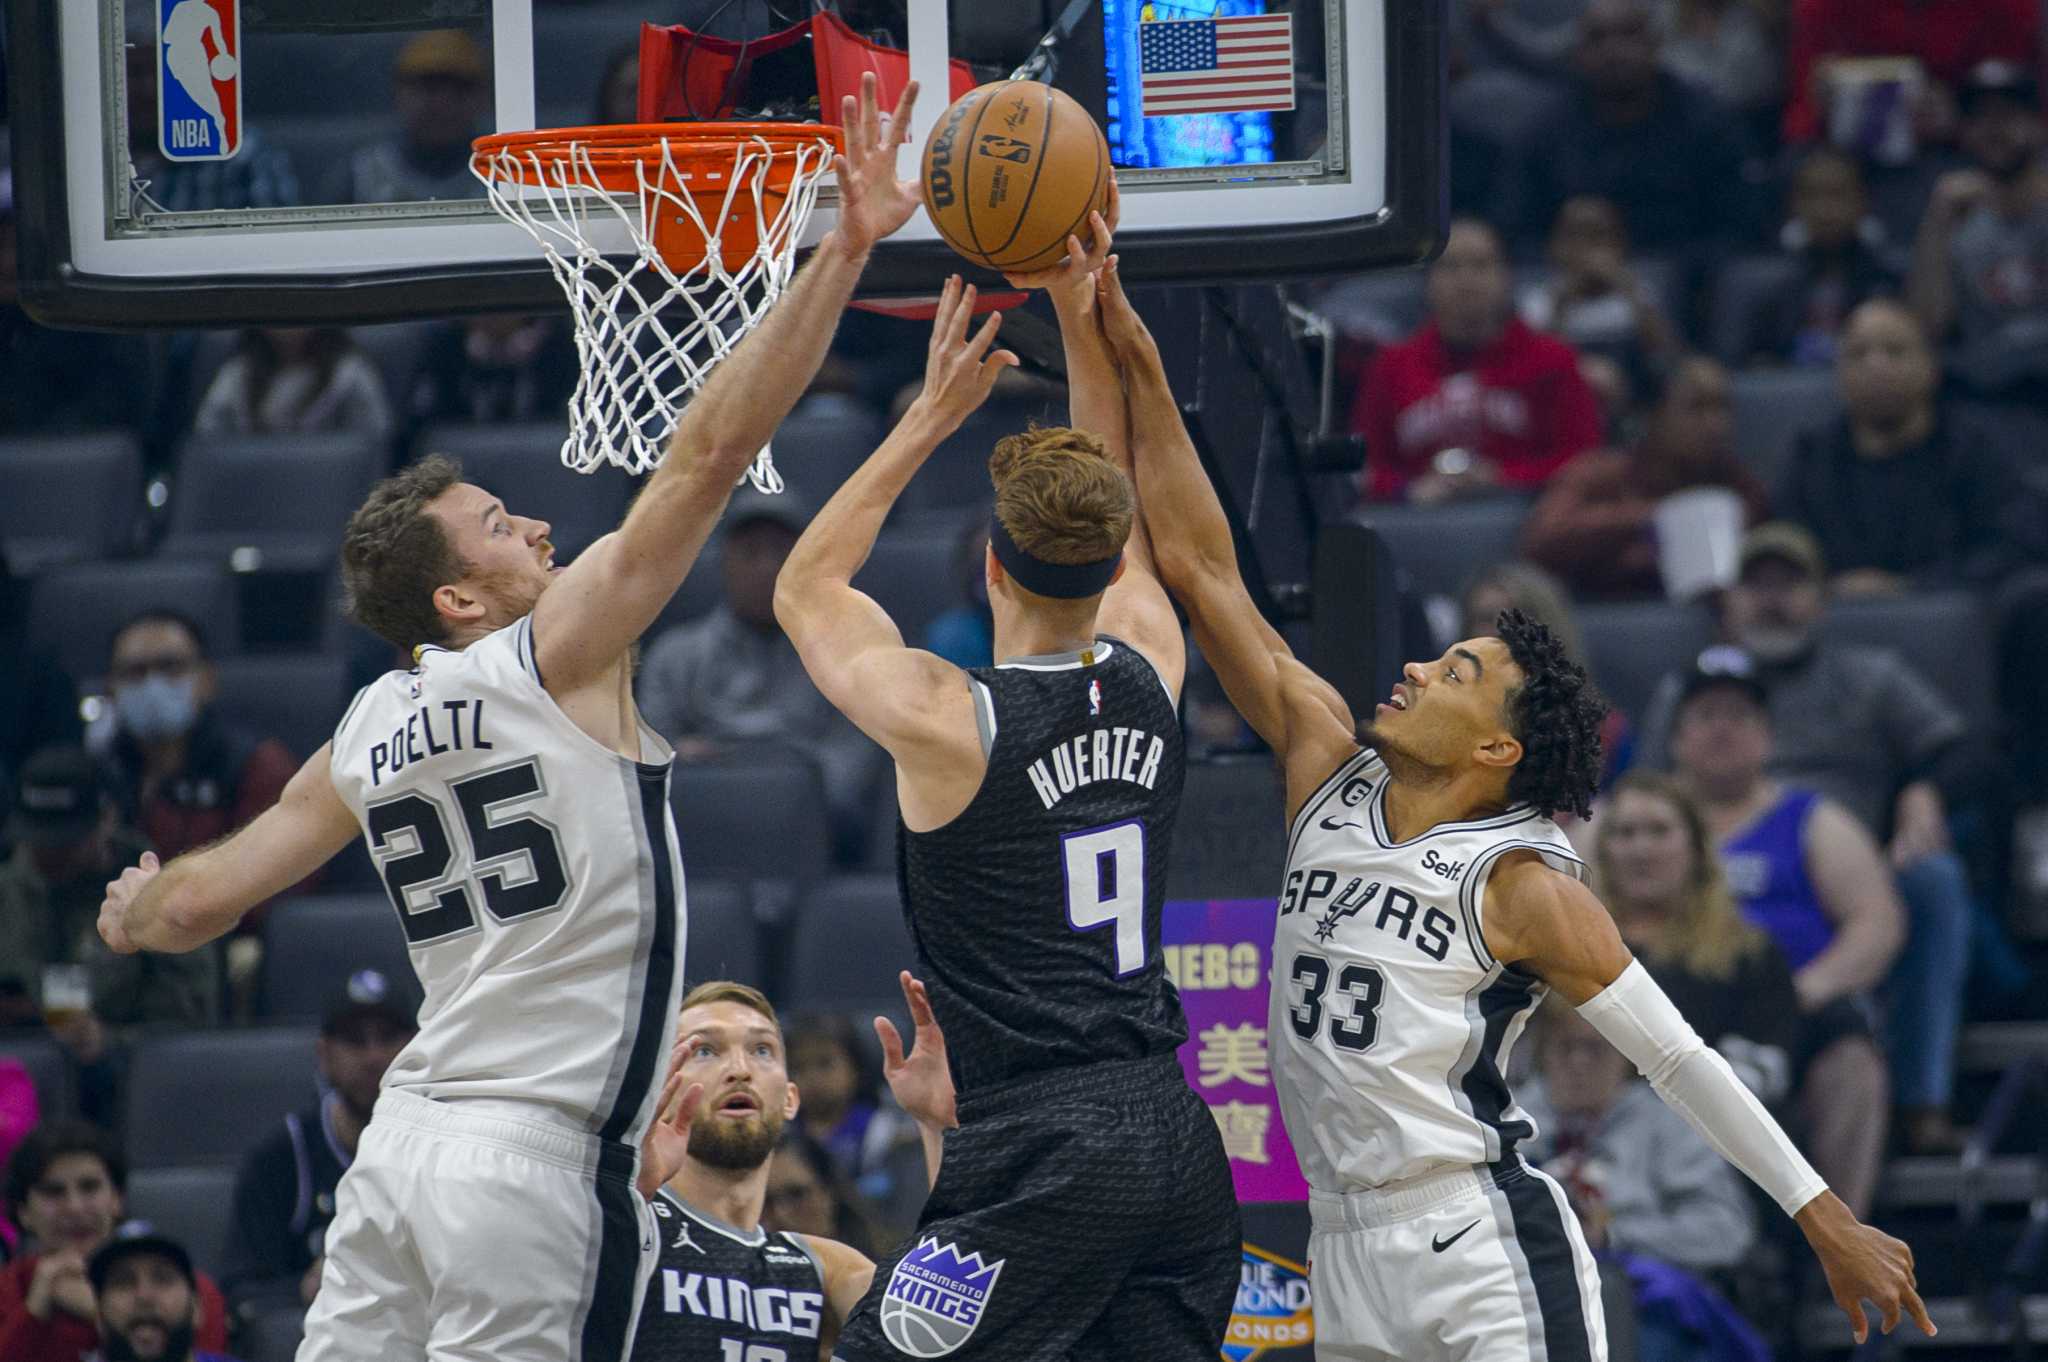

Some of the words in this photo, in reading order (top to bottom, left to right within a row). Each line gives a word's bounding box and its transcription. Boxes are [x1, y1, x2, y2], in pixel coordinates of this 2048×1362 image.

[172, 118, 211, 148] NBA
[370, 699, 493, 786] POELTL
[1026, 727, 1164, 810] HUERTER
[365, 754, 575, 950] 25
[1421, 850, 1467, 882] Self.
[1059, 816, 1146, 980] 9
[1281, 868, 1456, 962] SPURS
[1289, 952, 1388, 1055] 33
[662, 1268, 823, 1339] KINGS
[887, 1275, 981, 1327] KINGS
[900, 1262, 985, 1300] SACRAMENTO
